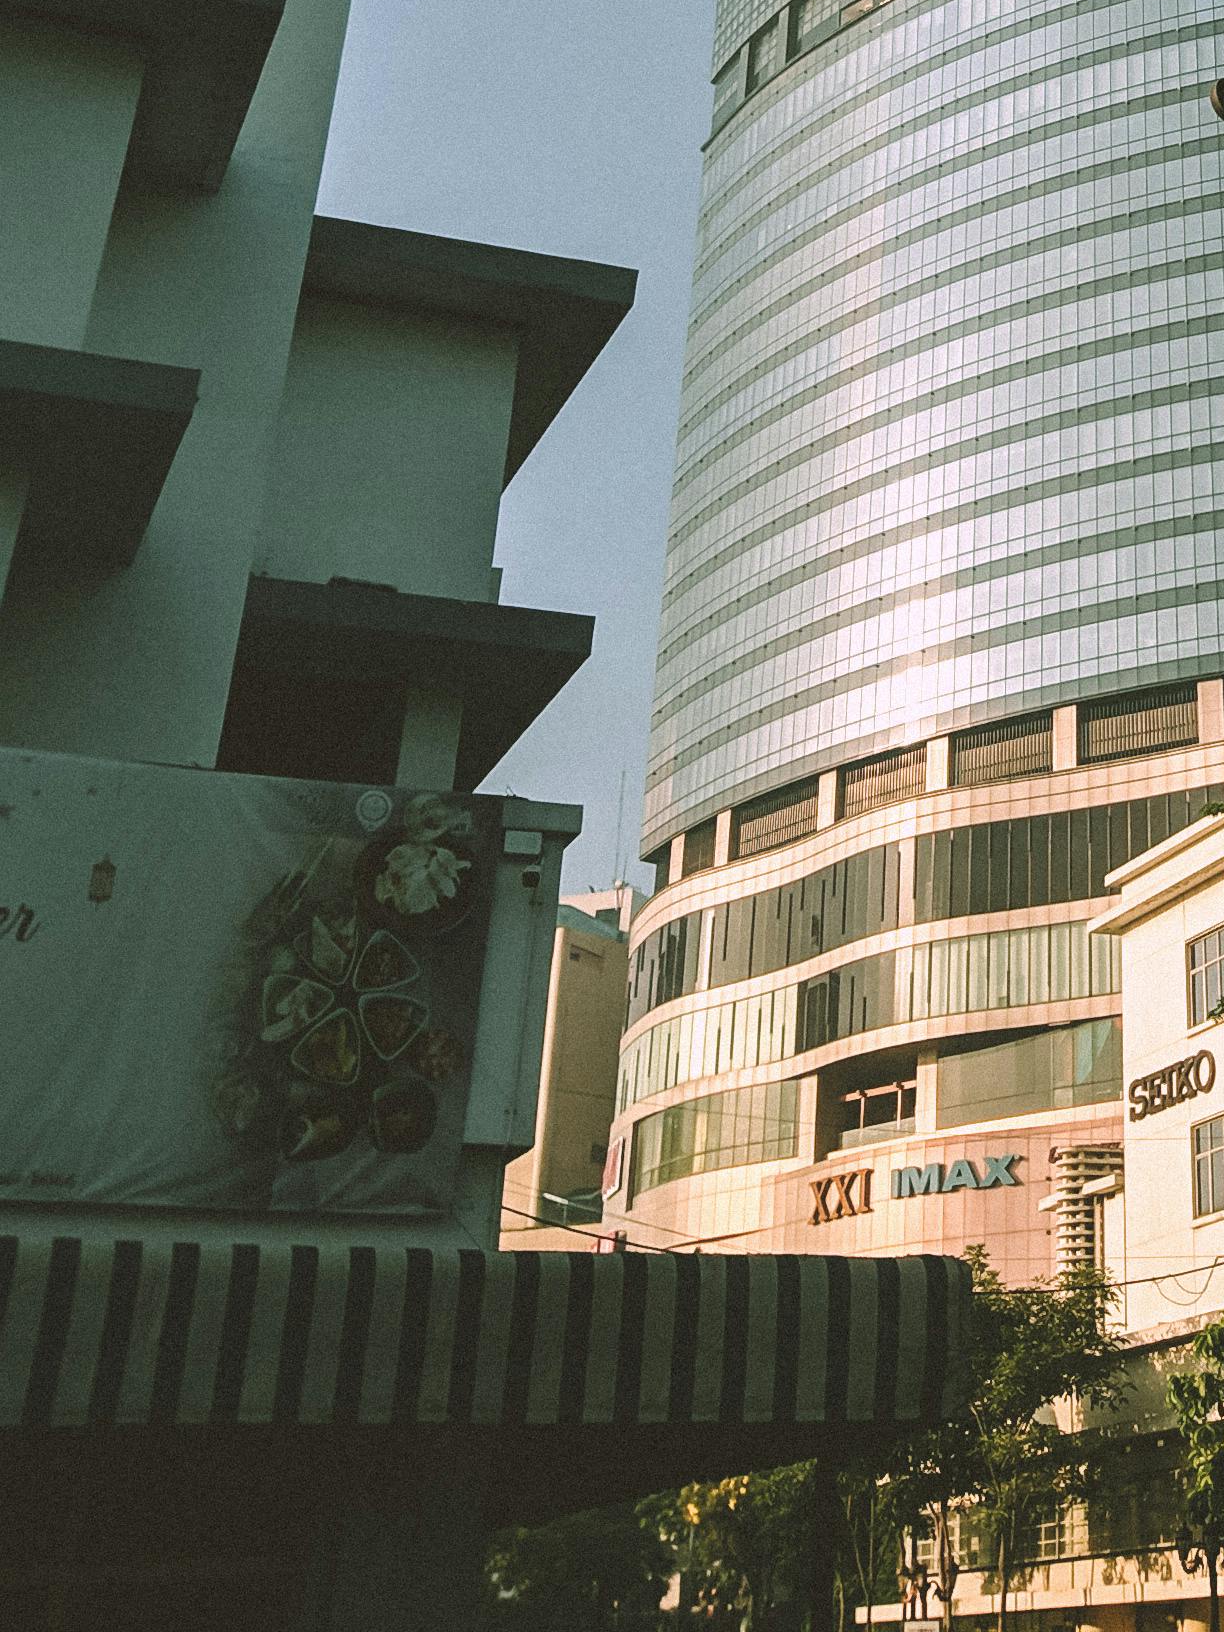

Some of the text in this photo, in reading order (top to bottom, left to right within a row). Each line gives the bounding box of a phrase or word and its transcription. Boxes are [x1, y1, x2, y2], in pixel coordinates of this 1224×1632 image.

[1129, 1050, 1216, 1122] SEIKO
[807, 1168, 875, 1225] XXI
[891, 1153, 1022, 1199] IMAX
